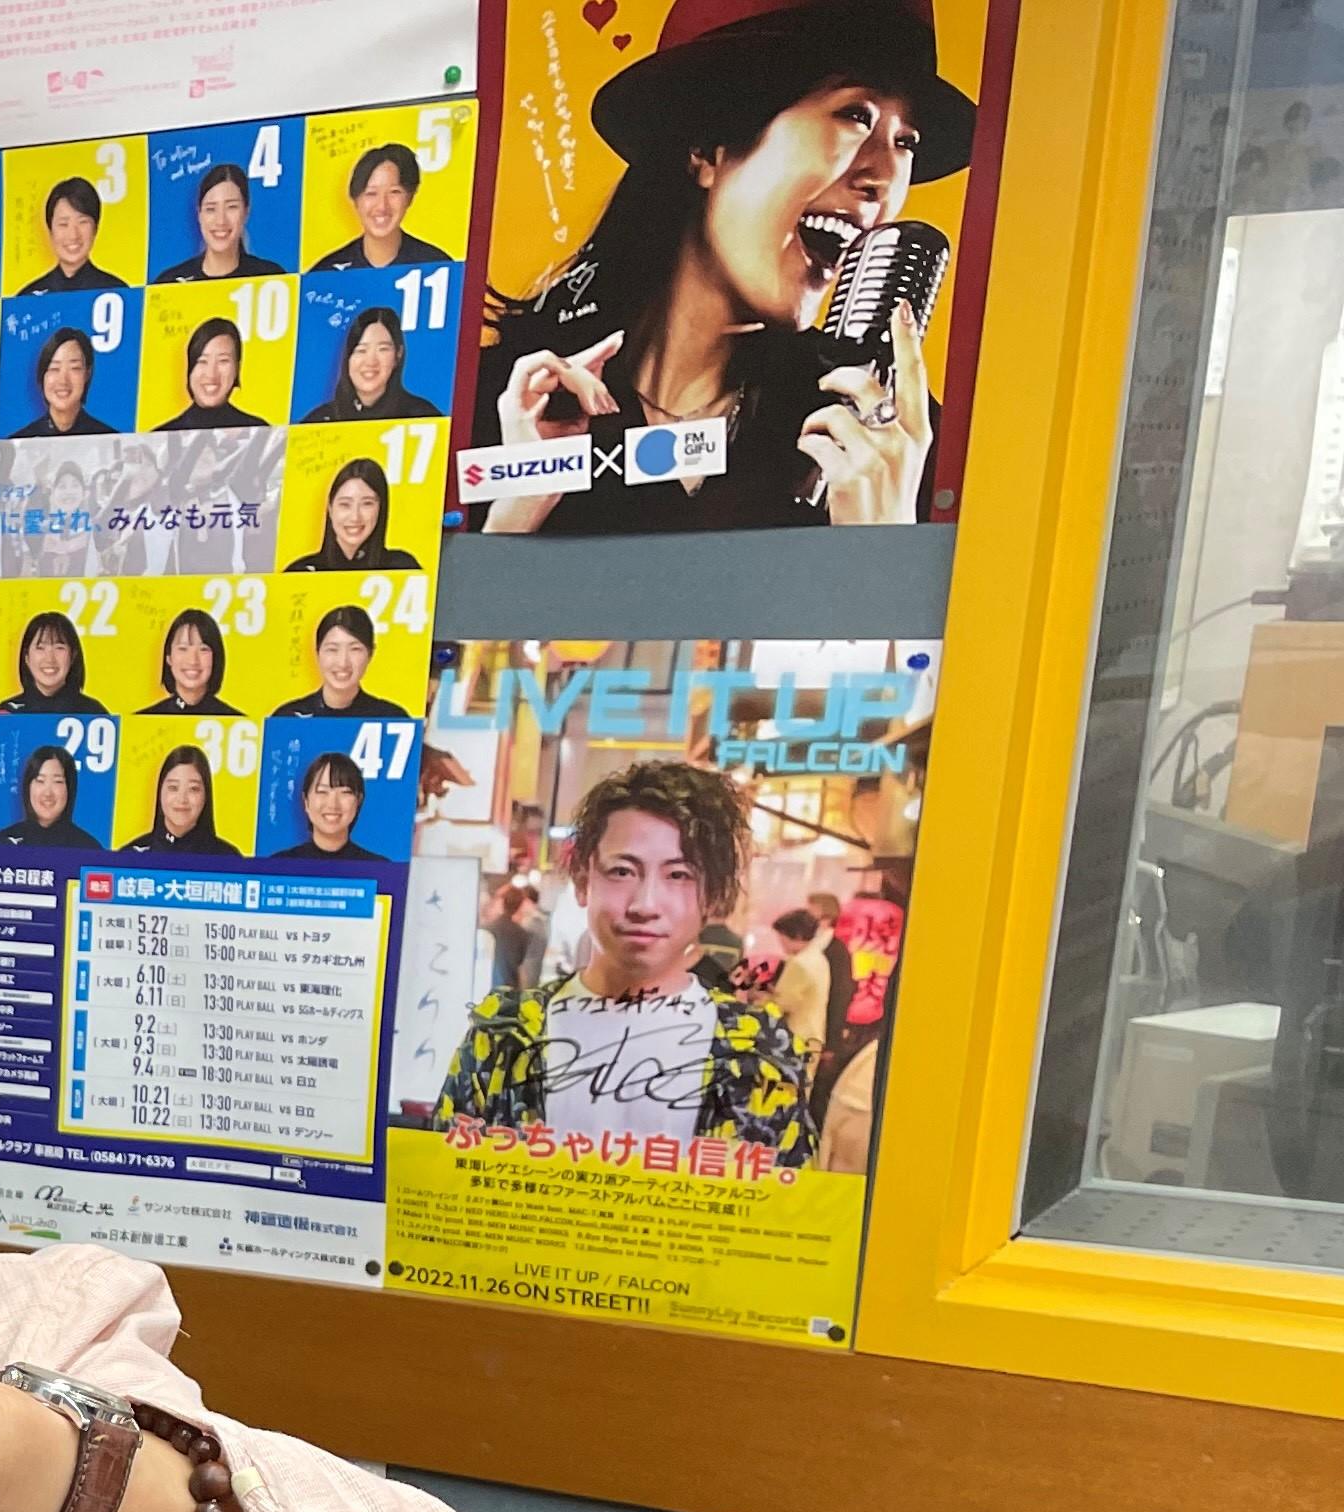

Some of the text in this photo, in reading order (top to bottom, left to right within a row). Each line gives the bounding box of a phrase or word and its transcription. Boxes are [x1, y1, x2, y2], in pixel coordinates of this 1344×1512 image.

[247, 124, 282, 188] 4
[416, 107, 454, 173] 5
[95, 142, 127, 204] 3
[230, 281, 287, 342] 10
[396, 267, 450, 331] 11
[90, 292, 124, 353] 9
[380, 424, 437, 485] 17
[684, 431, 705, 446] FM
[684, 441, 716, 456] GIFU
[490, 454, 585, 482] SUZUKI
[59, 582, 120, 638] 22
[203, 579, 268, 637] 23
[359, 575, 430, 635] 24
[438, 667, 916, 739] LIVE IT UP
[55, 717, 117, 774] 29
[194, 720, 259, 778] 36
[349, 722, 416, 780] 47
[716, 741, 907, 772] FALCON
[117, 876, 243, 905] 岐阜・大垣開催
[204, 944, 235, 961] 15:00
[238, 949, 256, 961] PLAY
[259, 951, 278, 962] BALL
[205, 922, 236, 941] 15:00
[239, 928, 257, 939] PLAY
[260, 929, 278, 941] BALL
[302, 931, 331, 942] トヨタ
[203, 995, 234, 1012] 13:30
[236, 1001, 254, 1012] PLAY
[257, 1002, 275, 1014] BALL
[204, 974, 235, 991] 13:30
[237, 979, 255, 991] PLAY
[257, 981, 276, 992] BALL
[203, 1023, 233, 1040] 13:30
[235, 1029, 254, 1041] PLAY
[256, 1031, 274, 1042] BALL
[298, 1034, 328, 1046] ホンダ
[203, 1044, 233, 1061] 13:30
[235, 1050, 253, 1062] PLAY
[255, 1052, 273, 1064] BALL
[202, 1066, 232, 1083] 18:30
[235, 1071, 252, 1084] PLAY
[255, 1074, 273, 1086] BALL
[200, 1114, 231, 1132] 13:30
[233, 1120, 251, 1132] PLAY
[254, 1122, 272, 1134] BALL
[201, 1093, 231, 1111] 13:30
[234, 1100, 251, 1111] PLAY
[254, 1101, 273, 1113] BALL
[90, 1151, 127, 1165] (0584)
[443, 1113, 798, 1186] ぶっちゃけ自信作。
[404, 1264, 651, 1316] 2022.11.26 ON STREET!!
[514, 1261, 690, 1296] LIVE IT UP FALCON
